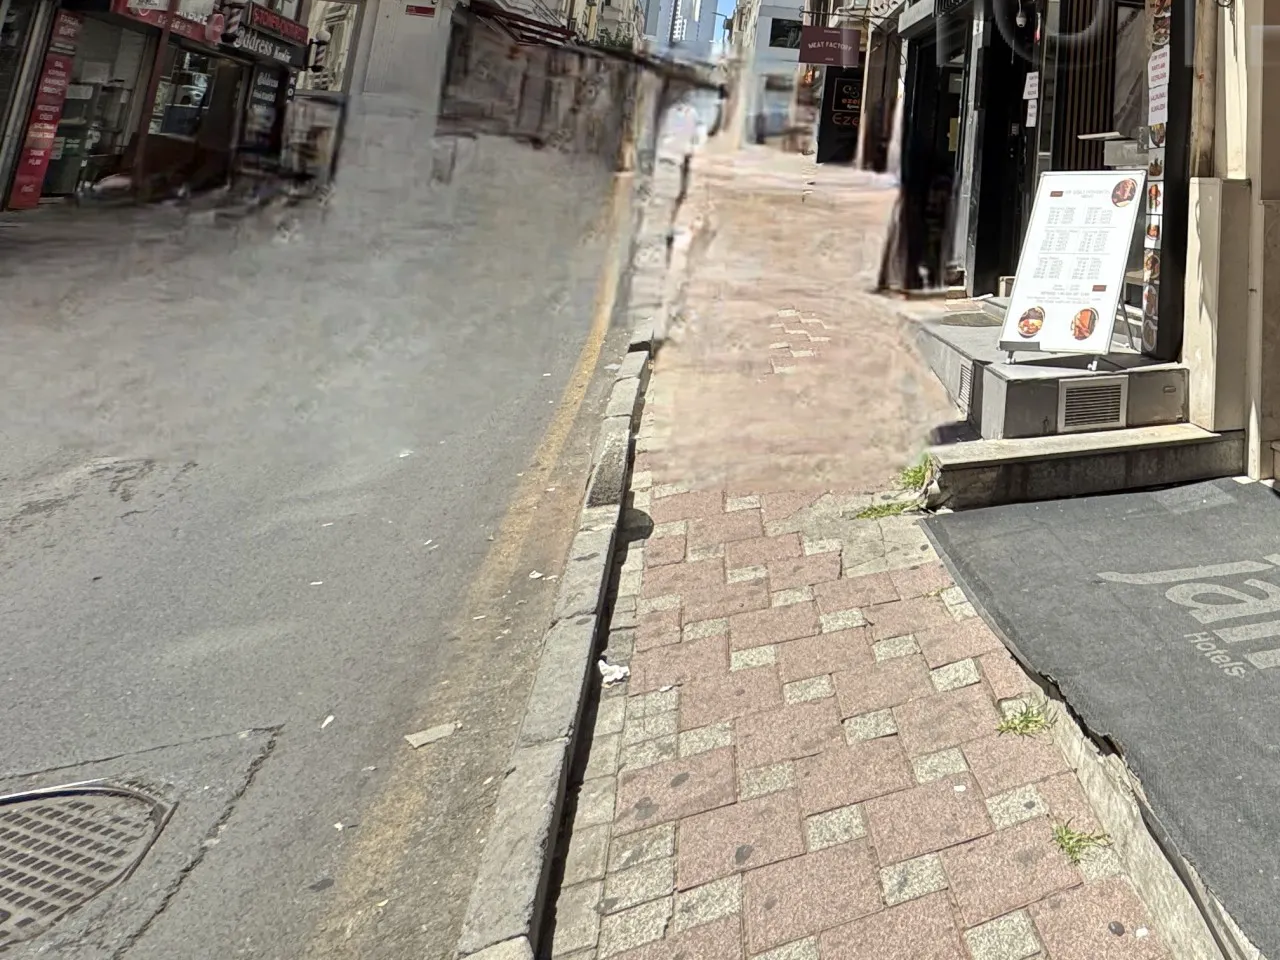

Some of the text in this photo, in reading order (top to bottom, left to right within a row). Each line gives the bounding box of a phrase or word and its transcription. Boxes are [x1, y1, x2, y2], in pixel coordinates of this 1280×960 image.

[808, 41, 852, 51] MEAT FACTORY
[1183, 631, 1248, 679] Hotels
